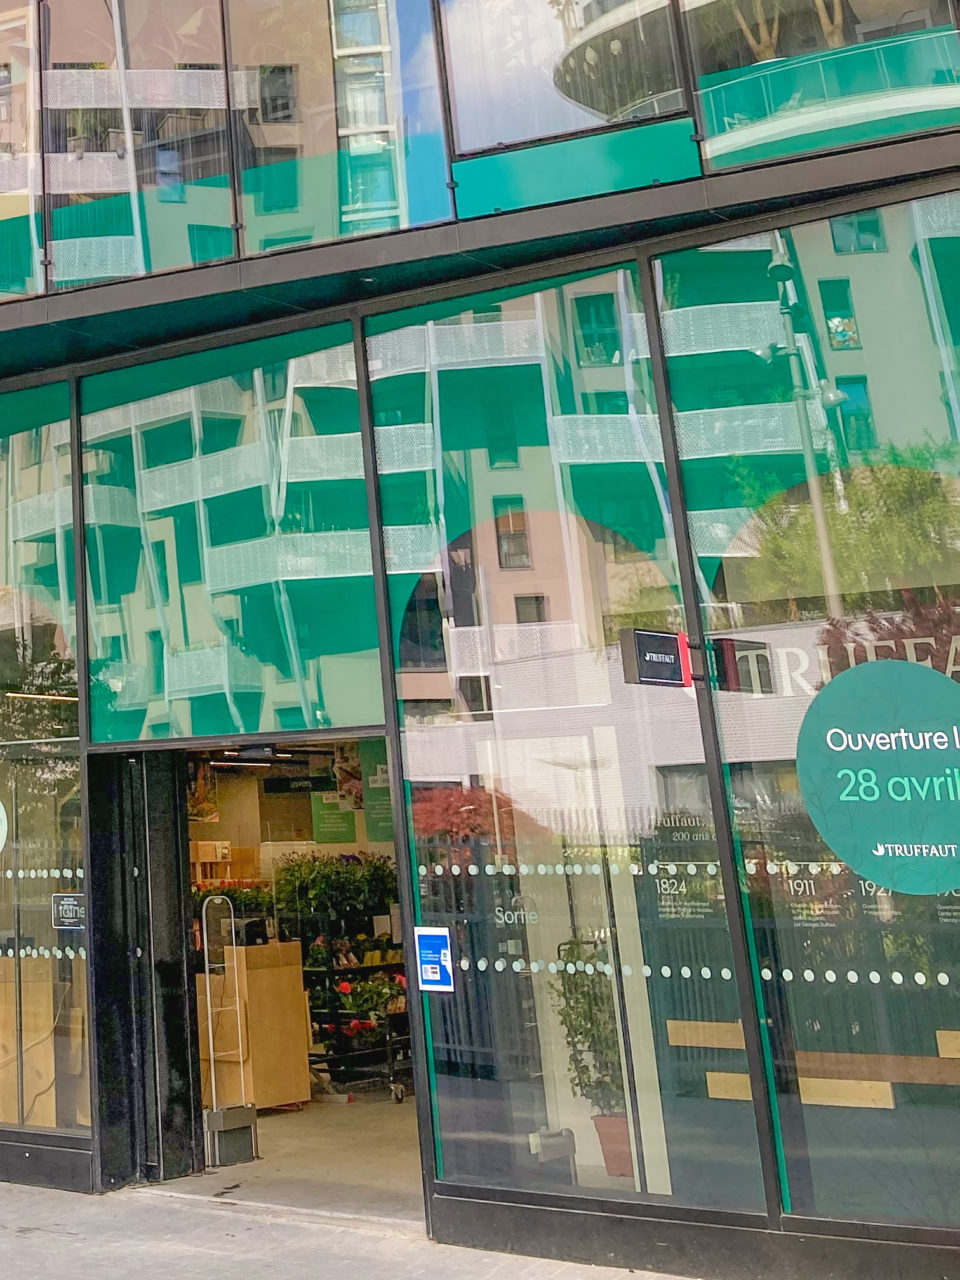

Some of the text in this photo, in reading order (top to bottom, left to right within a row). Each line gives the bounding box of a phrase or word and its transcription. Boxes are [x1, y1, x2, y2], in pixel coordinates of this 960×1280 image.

[826, 727, 949, 752] Ouverture
[837, 767, 960, 802] 28 avril
[672, 831, 690, 841] 200
[885, 843, 958, 858] TRUFFAUT
[655, 878, 688, 895] 1824
[788, 879, 816, 897] 1911
[494, 906, 538, 925] Sortie
